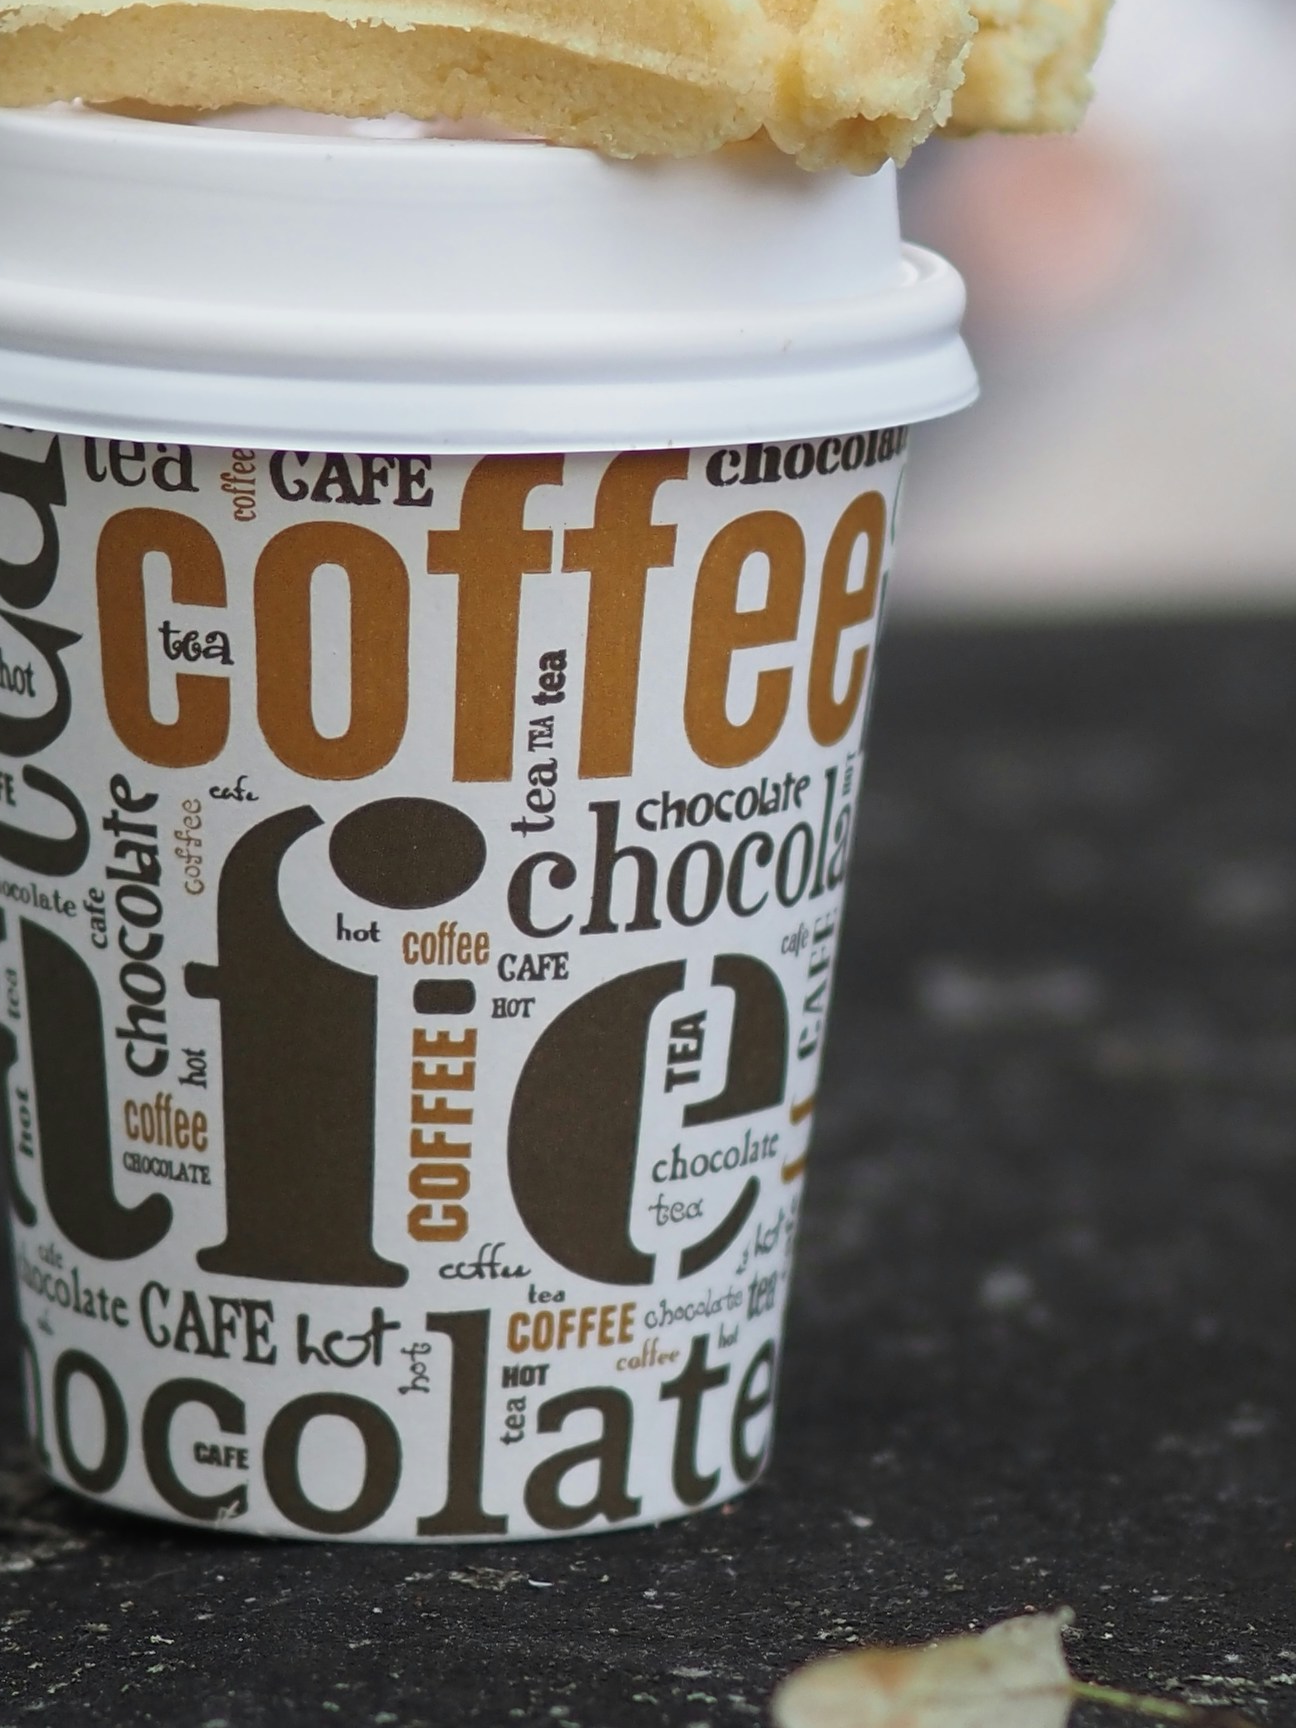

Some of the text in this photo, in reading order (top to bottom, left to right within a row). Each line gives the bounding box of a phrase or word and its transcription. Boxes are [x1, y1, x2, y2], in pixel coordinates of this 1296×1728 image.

[220, 448, 257, 522] coffee
[270, 450, 434, 506] CAFE
[95, 448, 888, 785] coffee
[158, 620, 235, 665] tea
[510, 648, 568, 838] tea TEA tea
[209, 775, 259, 802] cafe
[635, 772, 811, 831] chocolate
[173, 797, 206, 896] coffee
[83, 886, 108, 949] cafe
[102, 773, 170, 1078] chocolate
[336, 912, 381, 943] hot
[781, 922, 810, 958] cafe
[402, 921, 491, 966] coffee
[497, 952, 570, 982] CAFE
[491, 997, 536, 1019] HOT
[178, 1048, 208, 1089] hot
[664, 1009, 708, 1094] TEA
[15, 1088, 34, 1158] hot
[124, 1092, 209, 1153] coffee
[407, 1027, 478, 1242] COFFEE
[123, 1151, 212, 1186] CHOCOLATE
[651, 1128, 780, 1183] chocolate
[648, 1192, 704, 1227] tea
[438, 1242, 532, 1279] coffee
[528, 1283, 566, 1304] tea
[644, 1286, 744, 1329] chocolate
[746, 1270, 778, 1321] tea
[139, 1280, 279, 1366] CAFE
[296, 1306, 401, 1368] hot
[506, 1302, 637, 1354] COFFEE
[397, 1342, 432, 1396] hot
[501, 1363, 551, 1389] HOT
[615, 1337, 681, 1372] coffee
[500, 1394, 527, 1446] tea
[192, 1441, 250, 1470] CAFE
